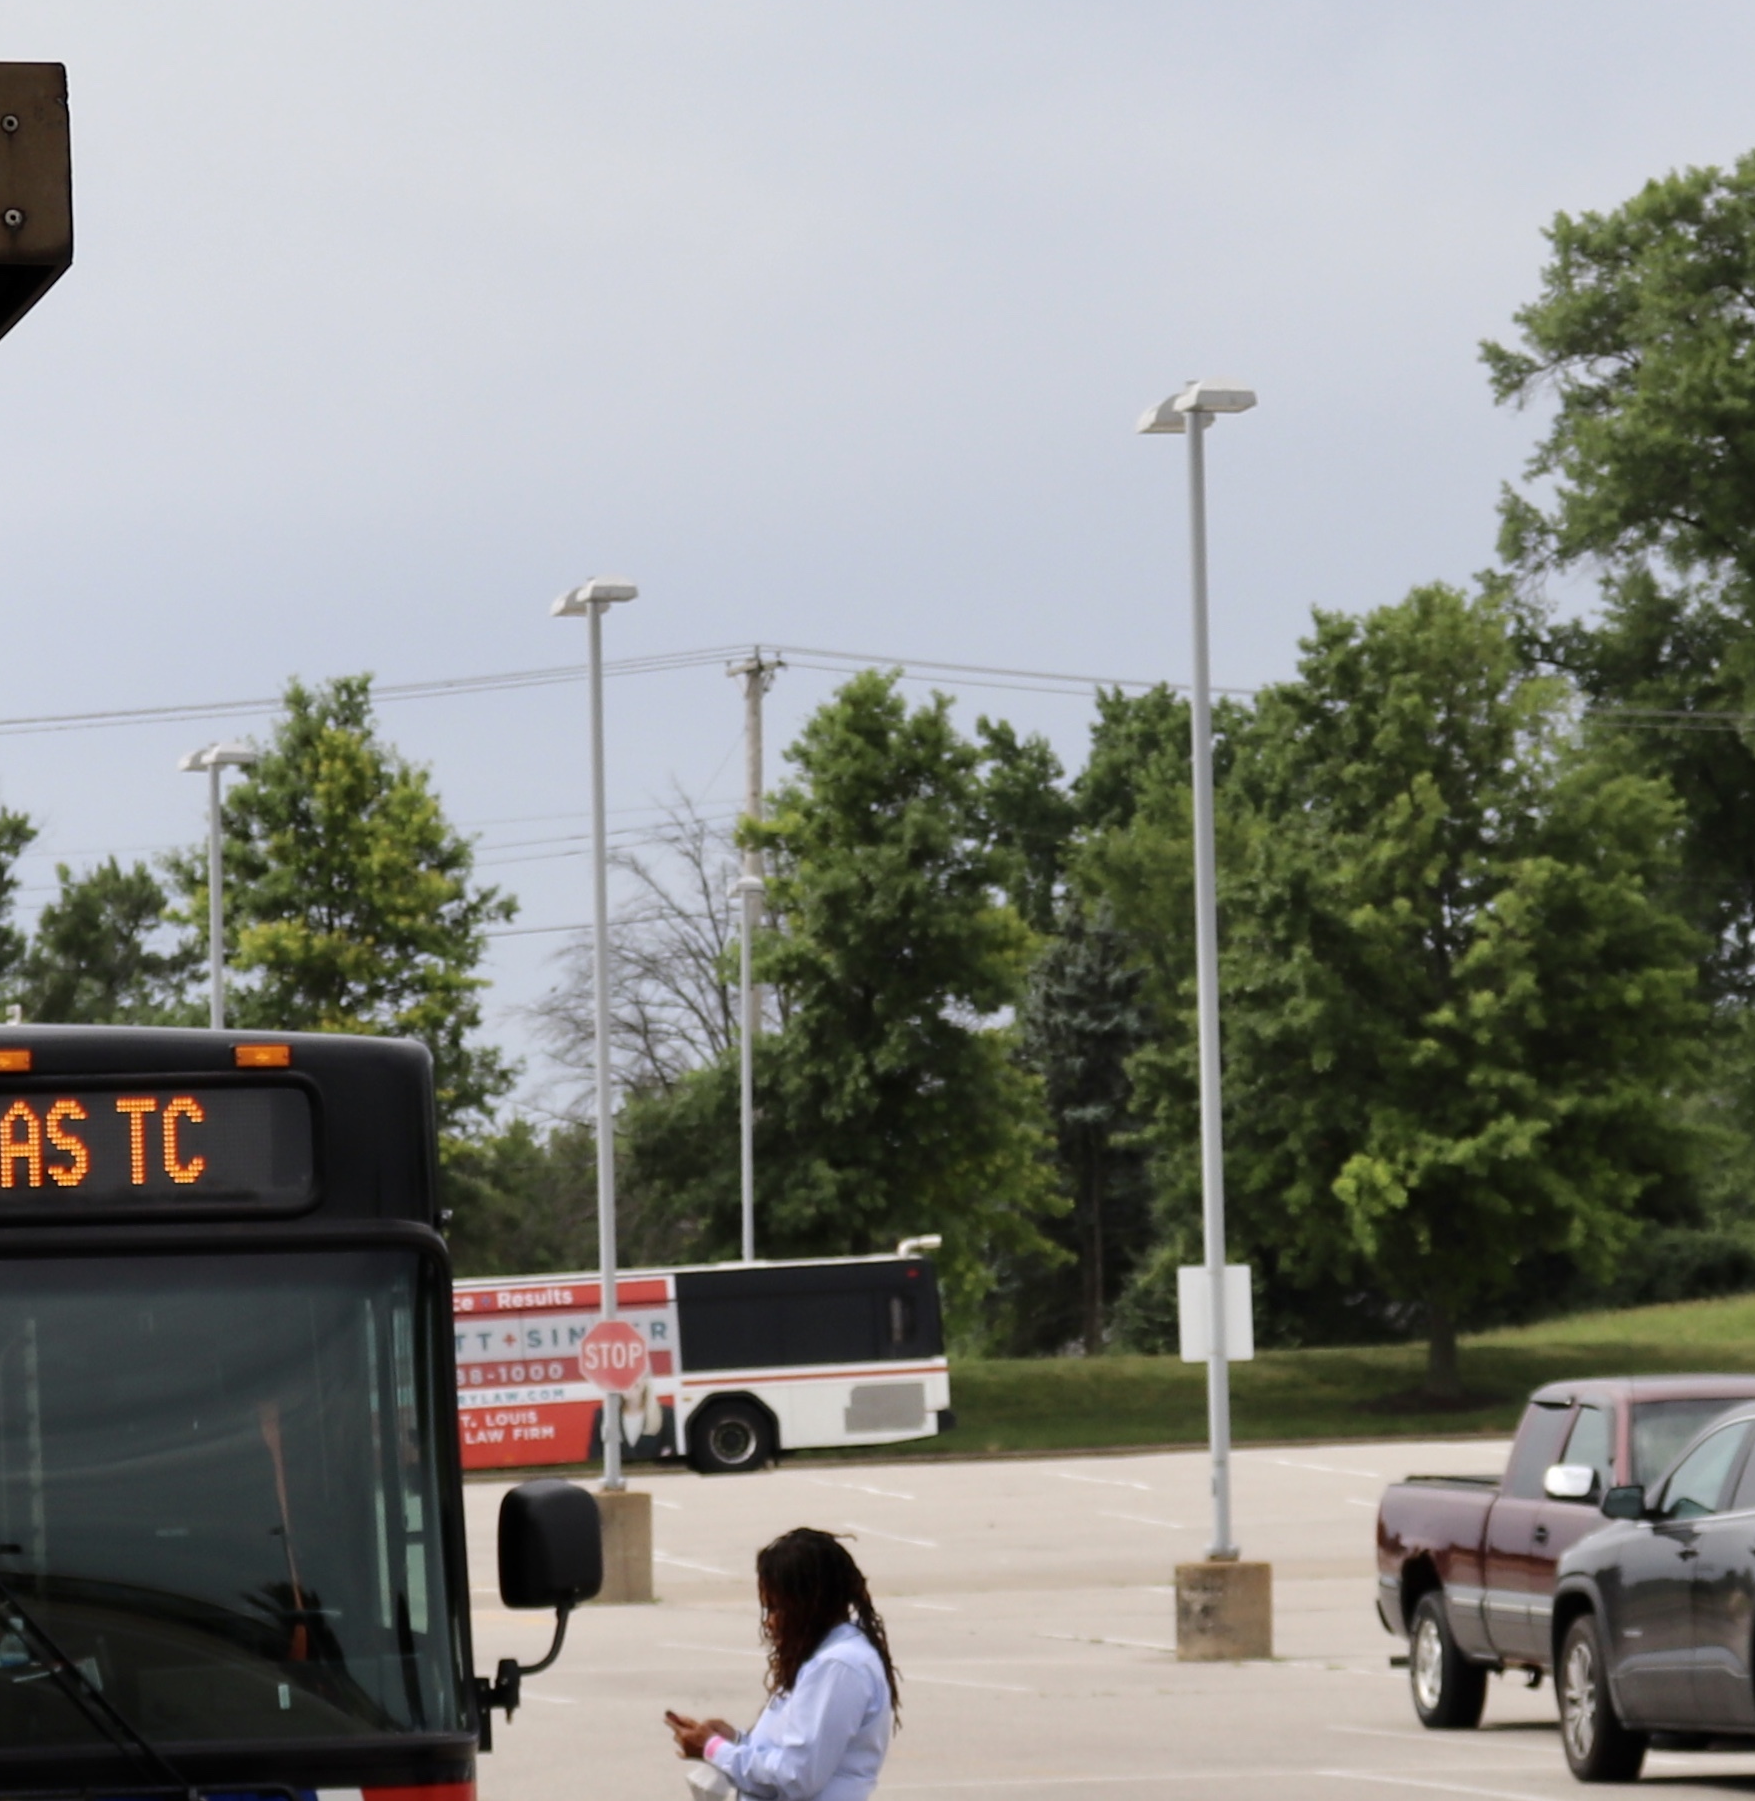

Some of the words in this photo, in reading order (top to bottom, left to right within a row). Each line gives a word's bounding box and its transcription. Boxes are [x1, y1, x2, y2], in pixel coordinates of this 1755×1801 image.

[116, 1096, 205, 1185] TC
[496, 1288, 574, 1309] Results
[585, 1344, 643, 1370] STOP
[484, 1410, 539, 1428] LOUIS
[464, 1429, 505, 1445] LAW
[512, 1426, 556, 1442] FIRM
